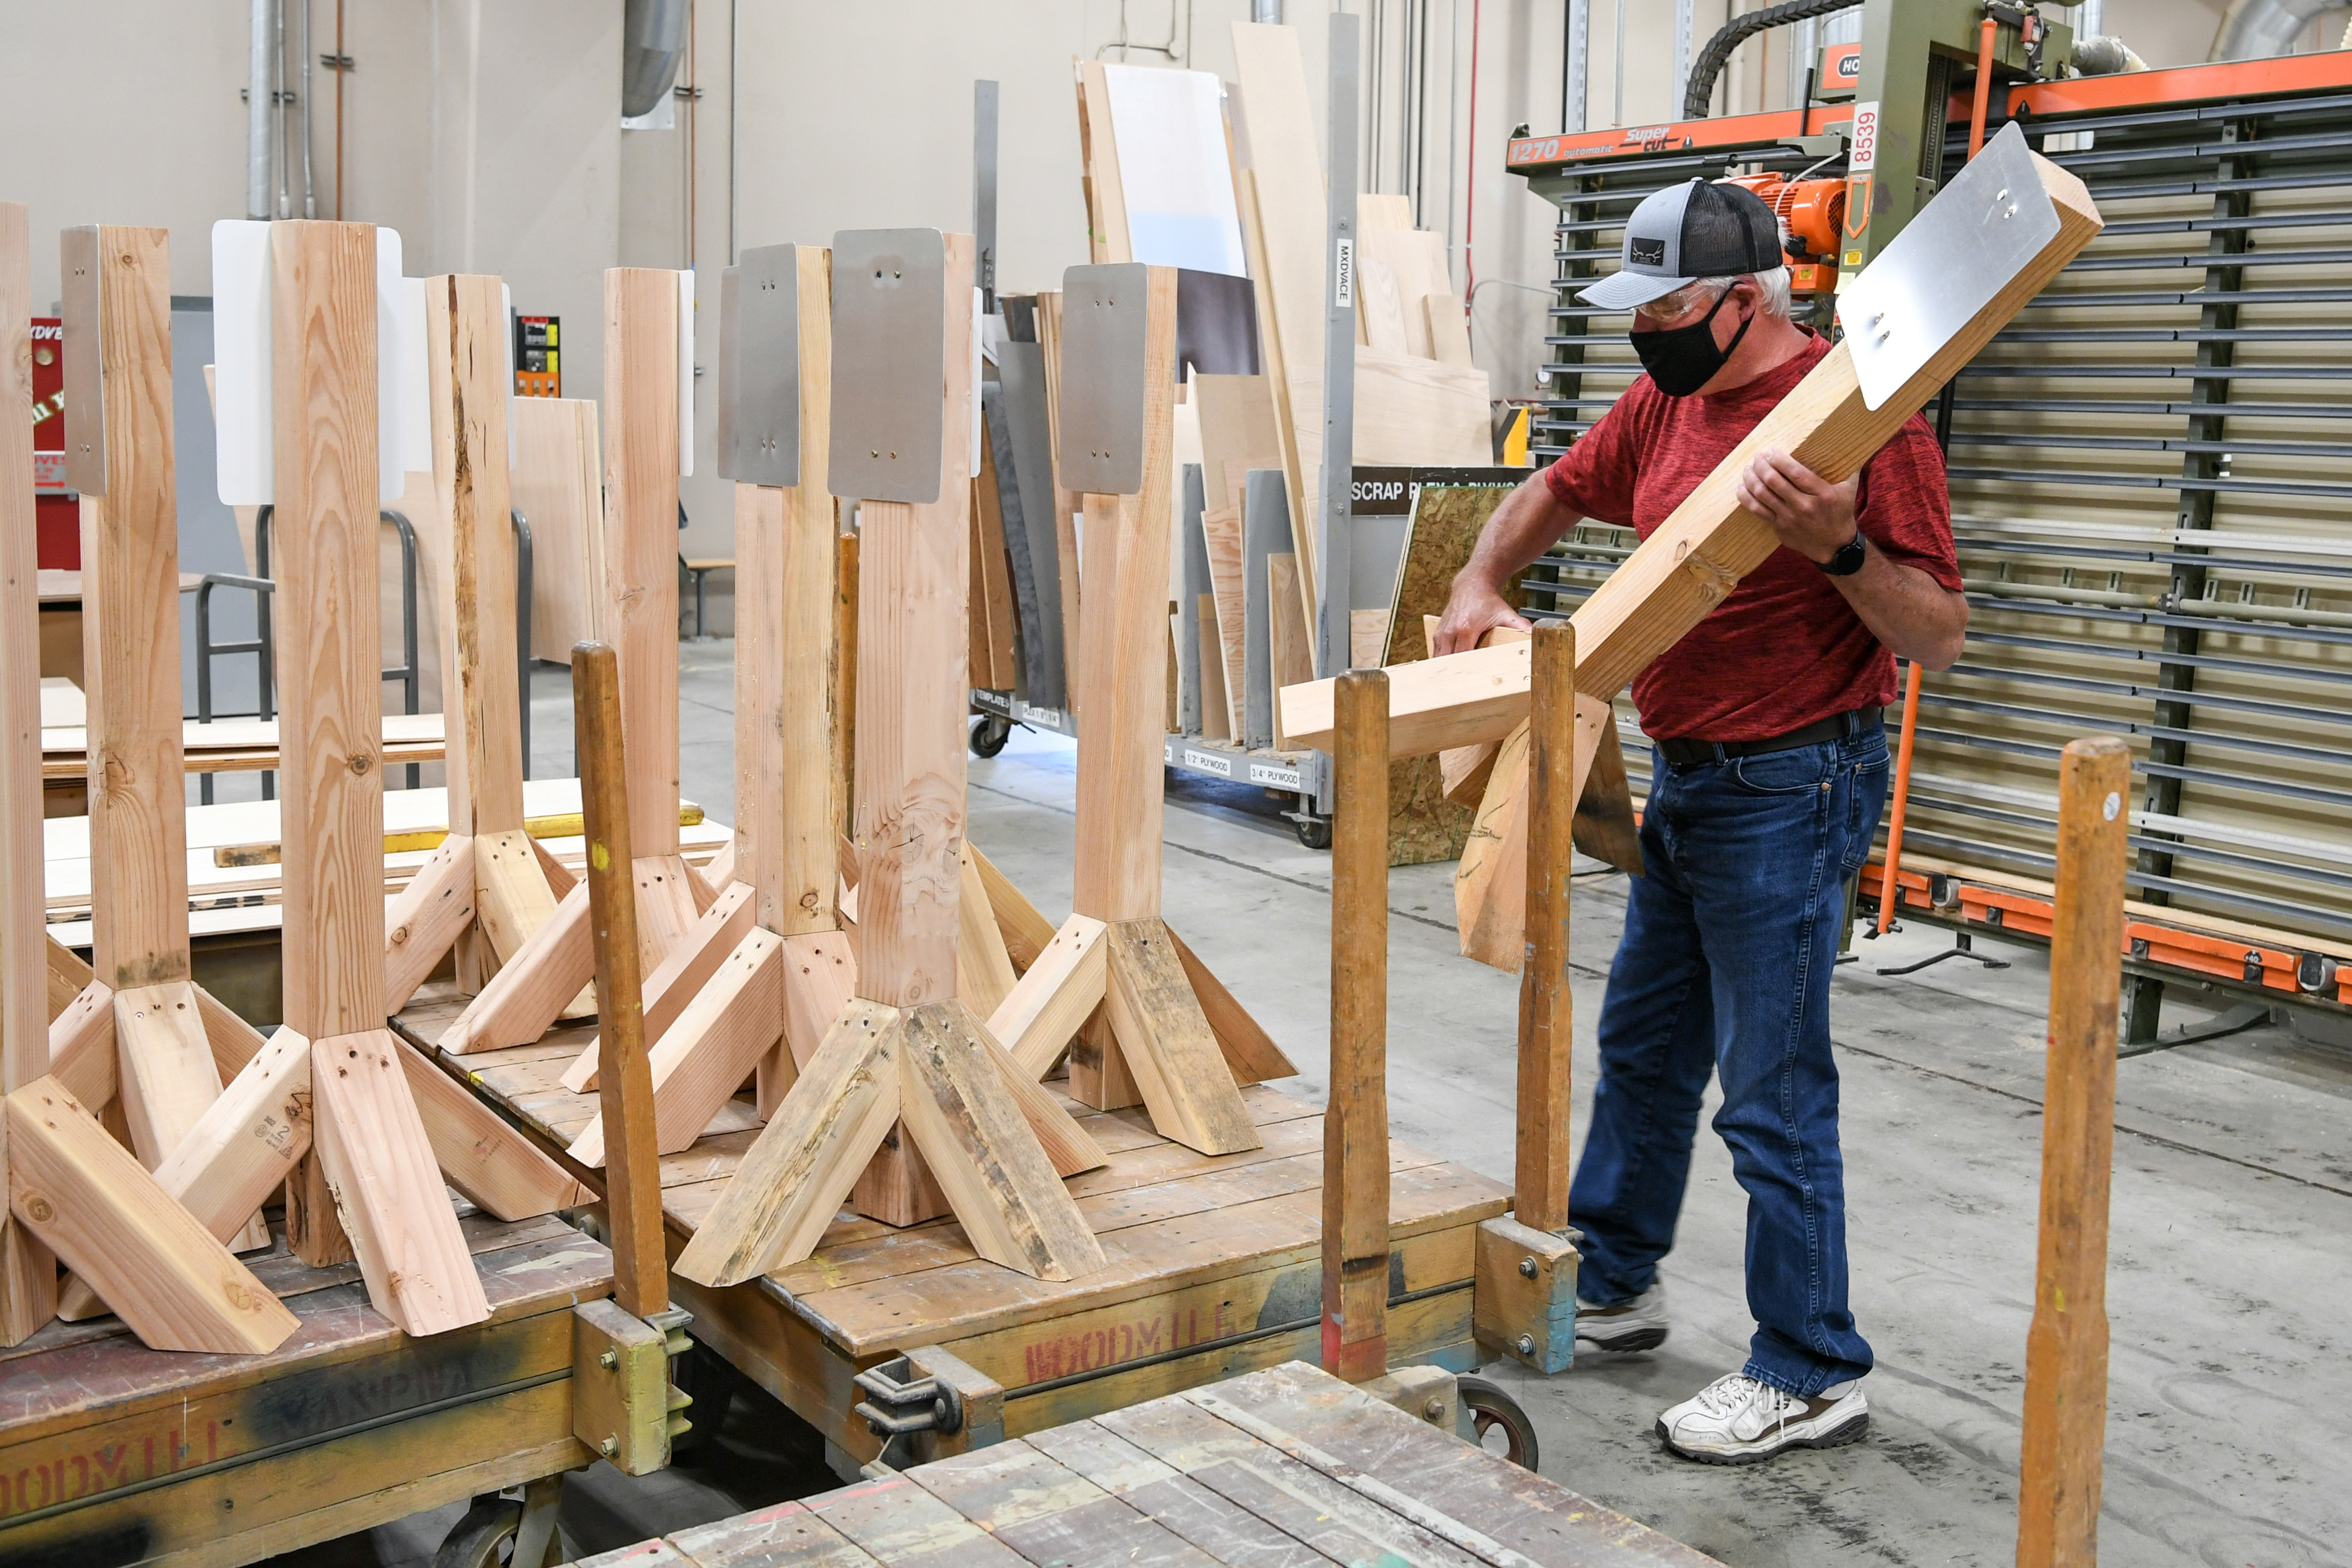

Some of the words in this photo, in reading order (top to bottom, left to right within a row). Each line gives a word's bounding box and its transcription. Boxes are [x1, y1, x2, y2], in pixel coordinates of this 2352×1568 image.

[1624, 127, 1670, 143] Super
[1854, 112, 1875, 162] 8539
[1511, 139, 1559, 162] 1270
[1564, 144, 1614, 157] automatic
[1340, 246, 1349, 300] MXDVACE
[1351, 482, 1403, 501] SCRAP
[976, 689, 1009, 708] TEMPLATES
[1201, 757, 1228, 771] PLYWOOD
[1252, 768, 1265, 778] 3/4"
[1268, 771, 1298, 784] PLYWOOD
